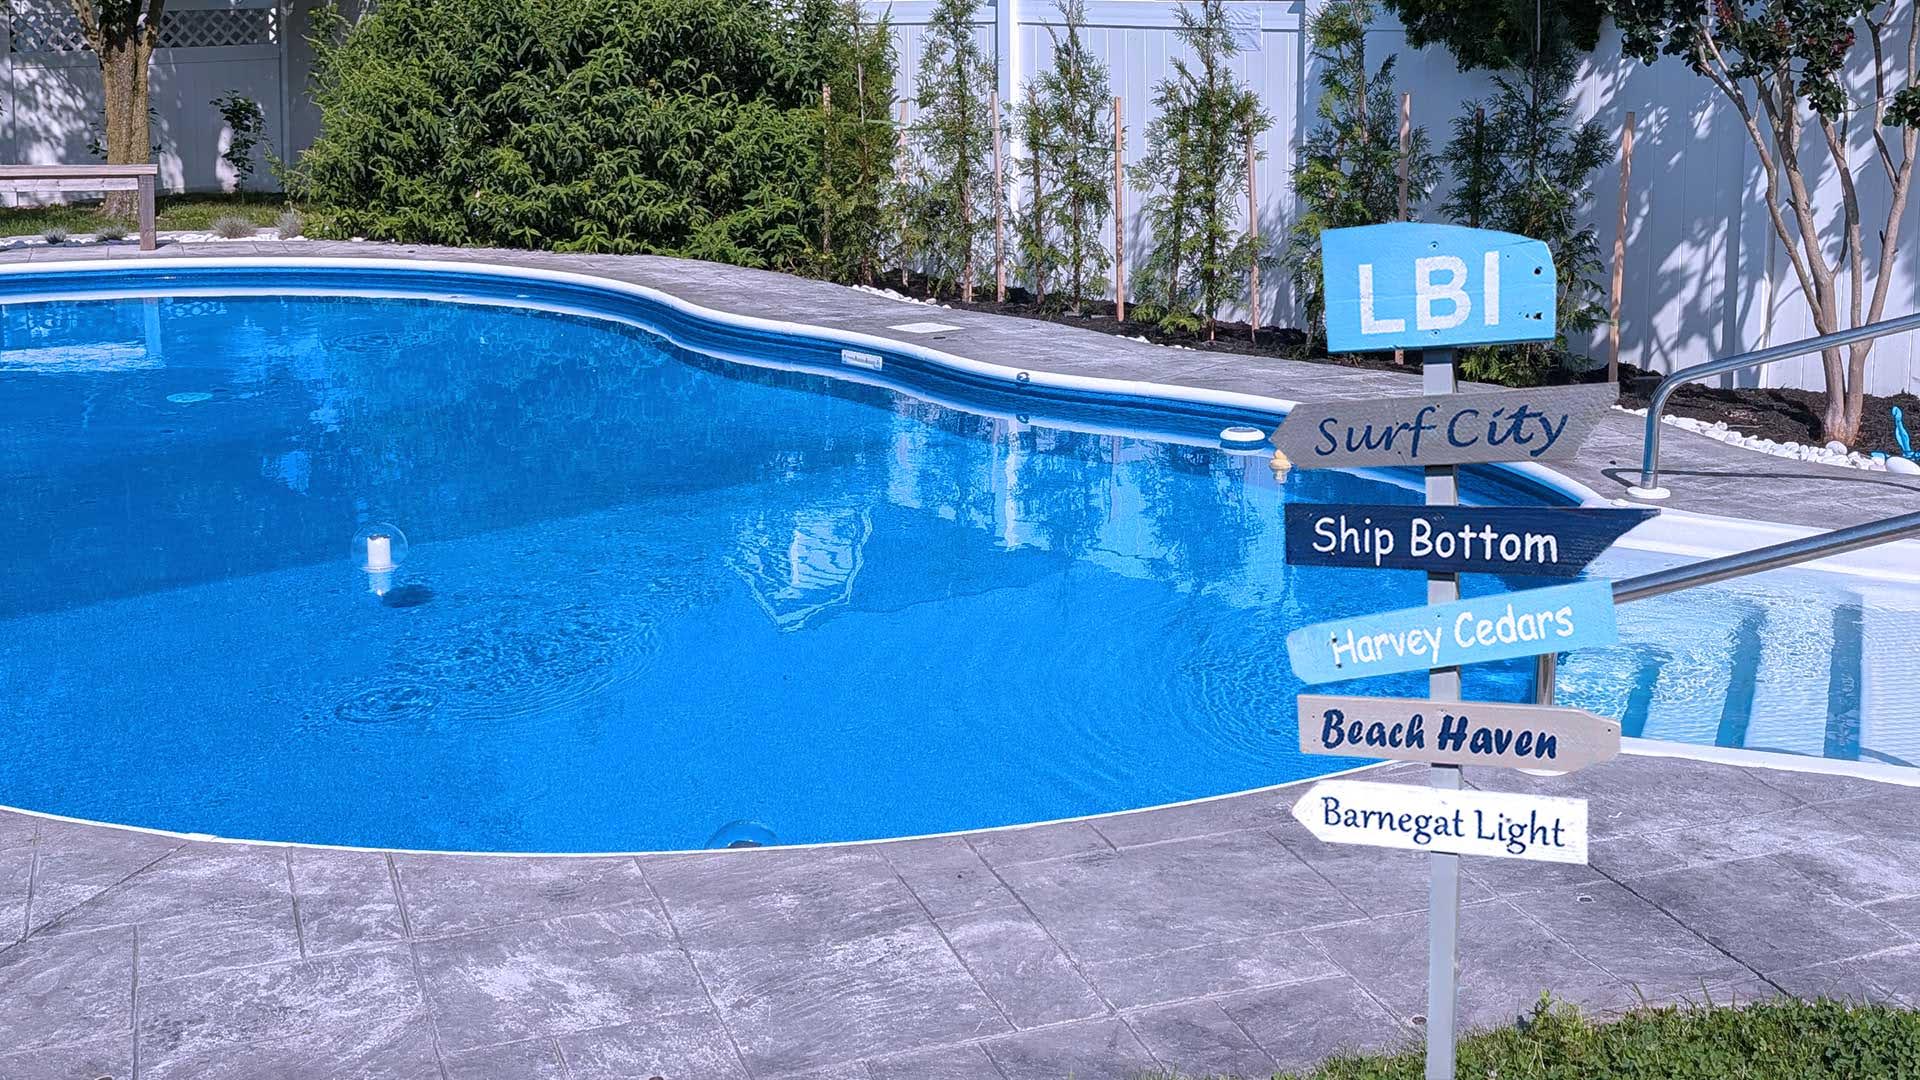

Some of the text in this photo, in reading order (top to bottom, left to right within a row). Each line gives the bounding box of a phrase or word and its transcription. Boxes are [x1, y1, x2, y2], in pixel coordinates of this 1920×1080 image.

[1358, 251, 1500, 335] LBI
[1314, 404, 1568, 457] Surf City
[1312, 517, 1558, 566] Ship Bottom
[1331, 604, 1574, 666] Harvey Cedars
[1320, 709, 1557, 759] Beach Haven
[1321, 797, 1566, 855] Barnegat Light
